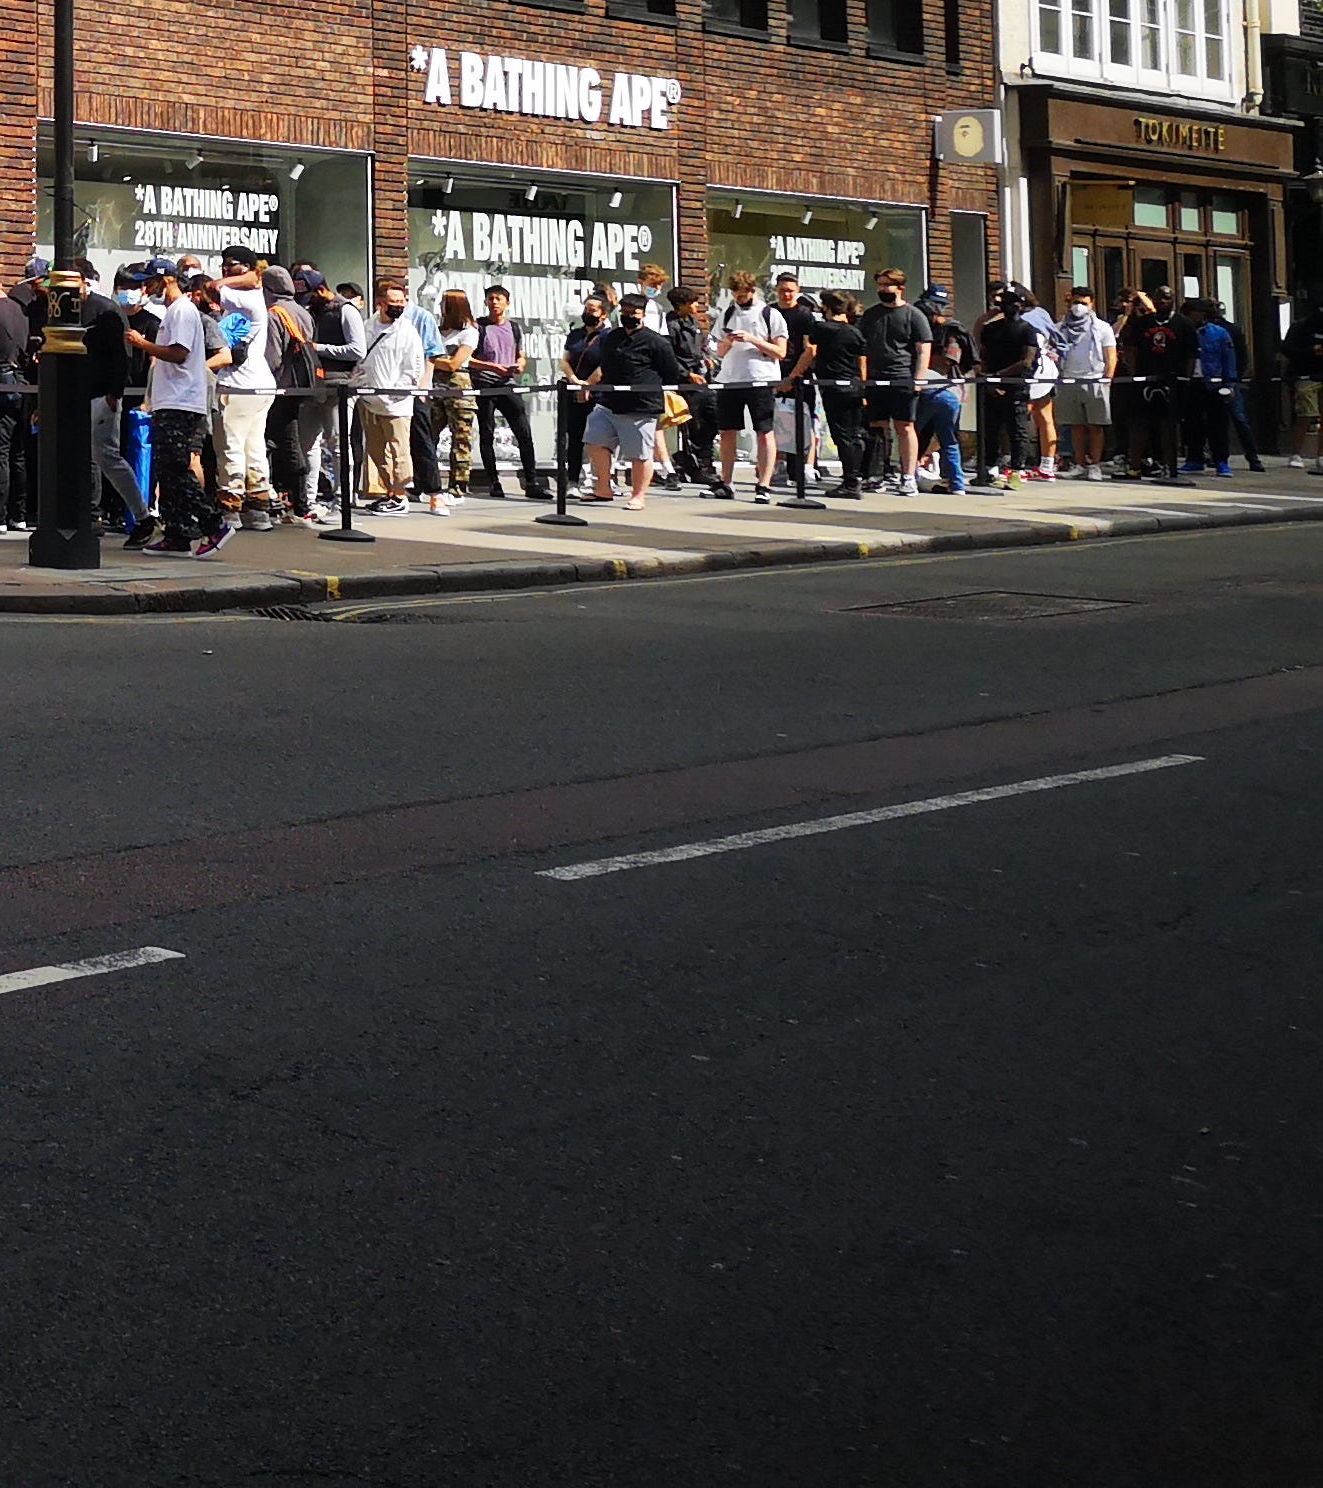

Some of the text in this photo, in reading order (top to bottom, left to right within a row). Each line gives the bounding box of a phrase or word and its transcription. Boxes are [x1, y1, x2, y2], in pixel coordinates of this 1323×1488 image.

[460, 51, 603, 123] BATHING
[160, 186, 234, 220] BATHING
[134, 220, 279, 255] 28TH ANNIVERSARY
[472, 212, 585, 268] BATHING
[786, 236, 836, 264] BATHING
